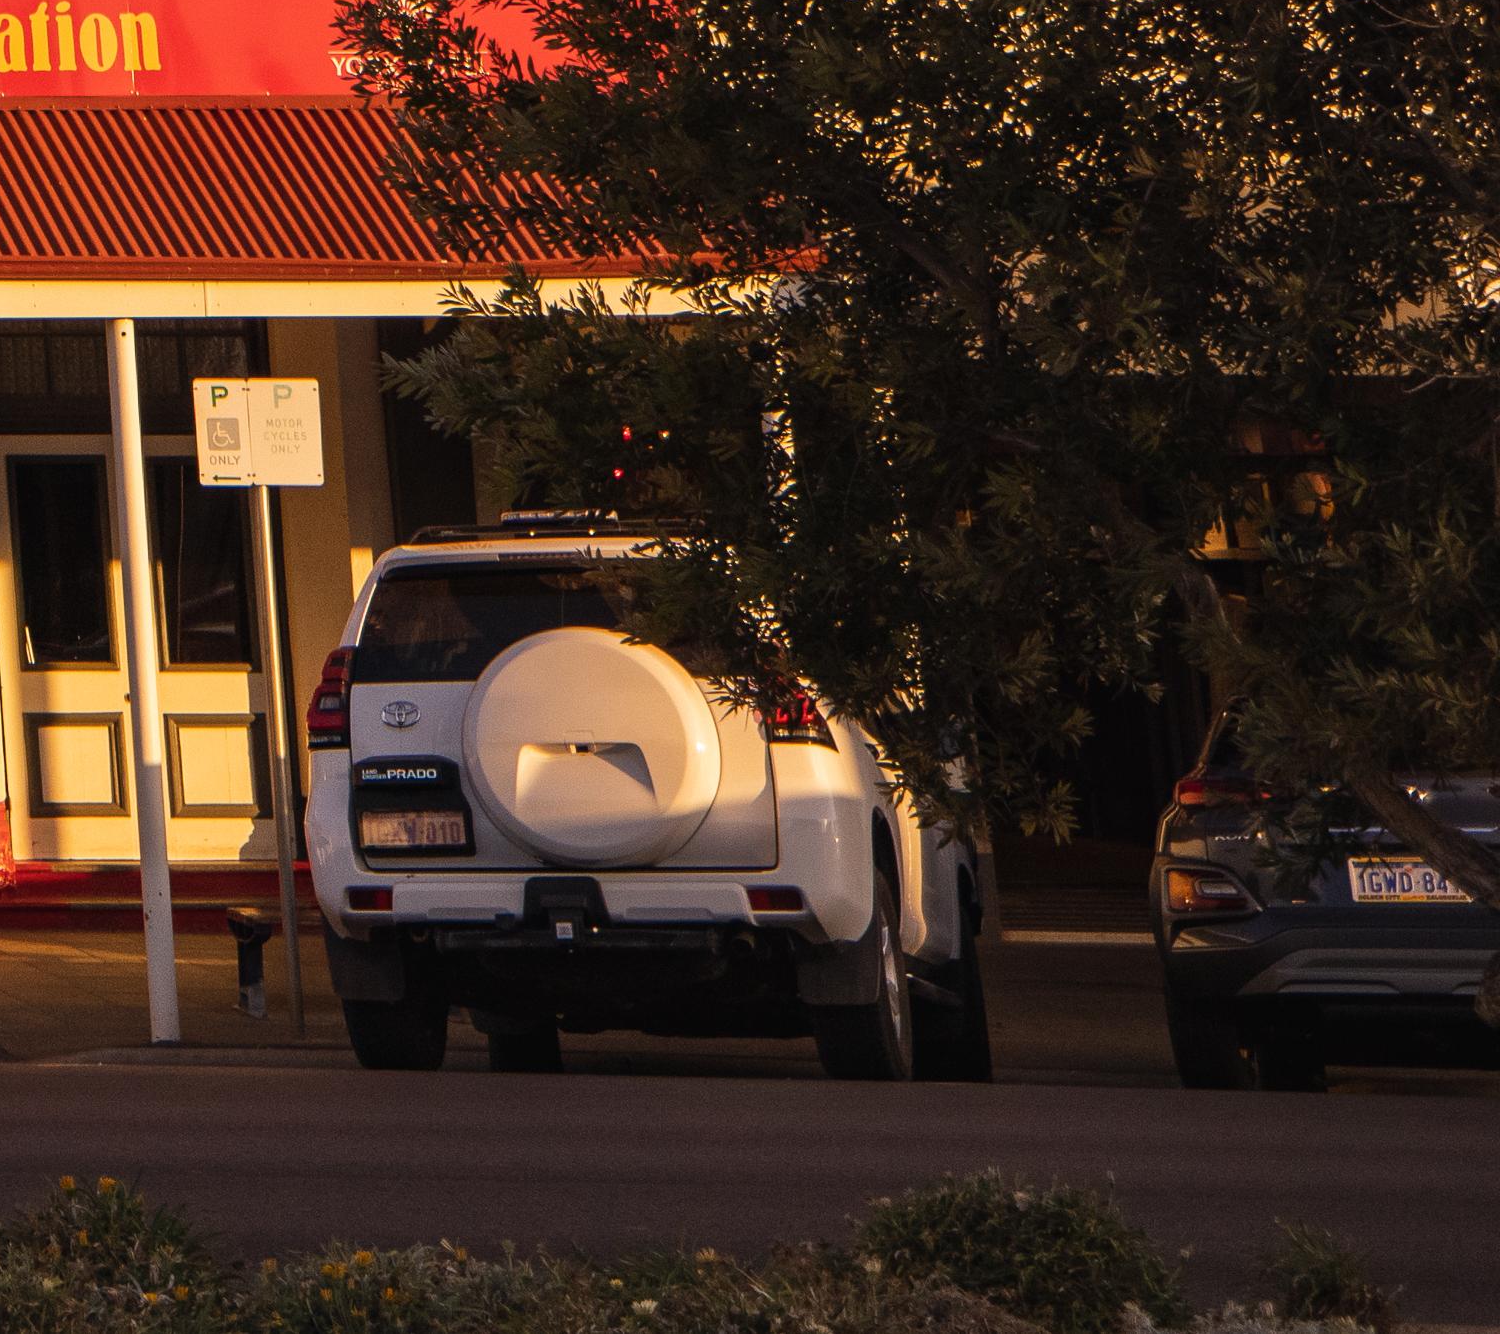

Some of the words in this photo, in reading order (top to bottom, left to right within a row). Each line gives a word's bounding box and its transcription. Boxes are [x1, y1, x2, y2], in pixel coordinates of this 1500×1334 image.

[210, 385, 229, 407] P
[273, 384, 292, 409] P
[266, 419, 303, 429] MOTOR
[263, 431, 308, 441] CYCLES
[271, 444, 301, 454] ONLY
[209, 455, 241, 466] ONLY
[386, 768, 438, 780] PRADO
[1358, 872, 1414, 894] 1GWD
